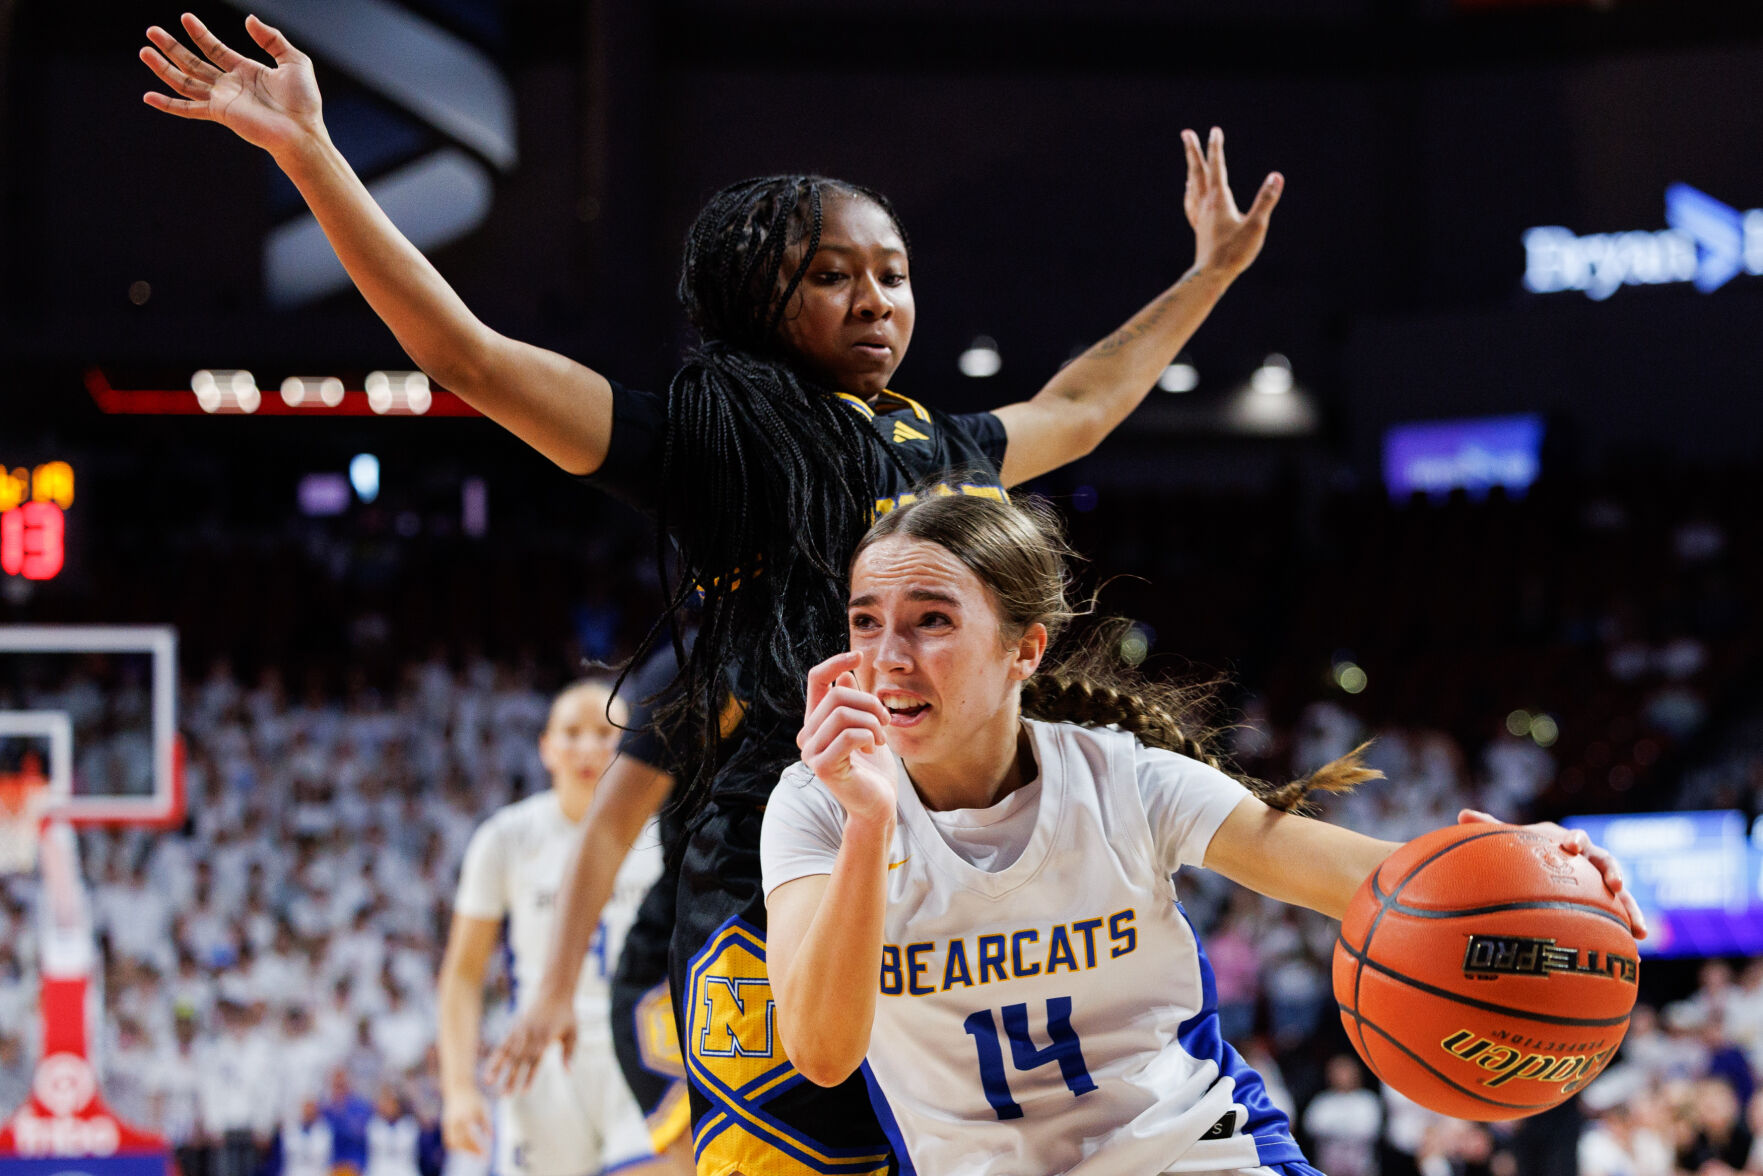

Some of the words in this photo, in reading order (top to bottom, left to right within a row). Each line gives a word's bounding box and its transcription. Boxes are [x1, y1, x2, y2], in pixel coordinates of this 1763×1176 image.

[880, 908, 1137, 996] BEARCATS
[1468, 940, 1540, 972] PRO
[1542, 947, 1637, 986] ELITE
[700, 975, 776, 1058] N
[963, 996, 1099, 1120] 14
[1441, 1029, 1619, 1094] Baden
